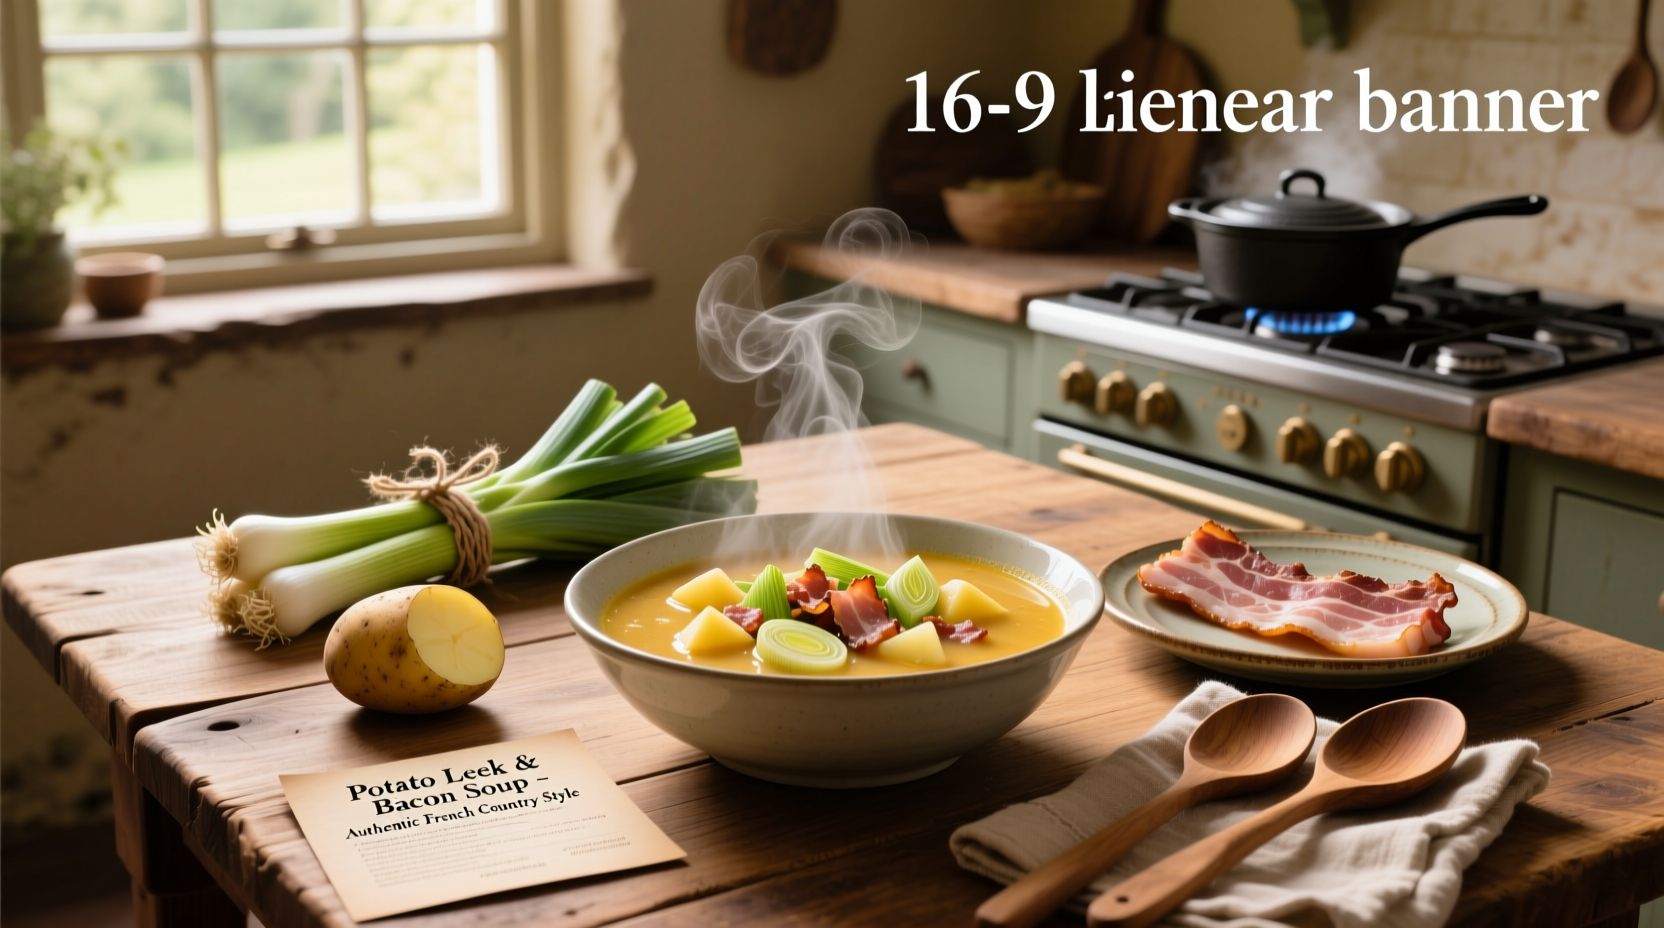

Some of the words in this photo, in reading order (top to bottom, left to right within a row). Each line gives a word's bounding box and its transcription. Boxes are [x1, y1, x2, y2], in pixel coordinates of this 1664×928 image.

[346, 774, 436, 802] Potato
[441, 759, 508, 785] Leek
[515, 754, 540, 771] &
[372, 791, 458, 816] Bacon
[463, 776, 529, 799] Soup
[346, 816, 420, 839] Authentic
[423, 807, 475, 825] French
[478, 796, 539, 815] Country
[542, 787, 580, 804] Style
